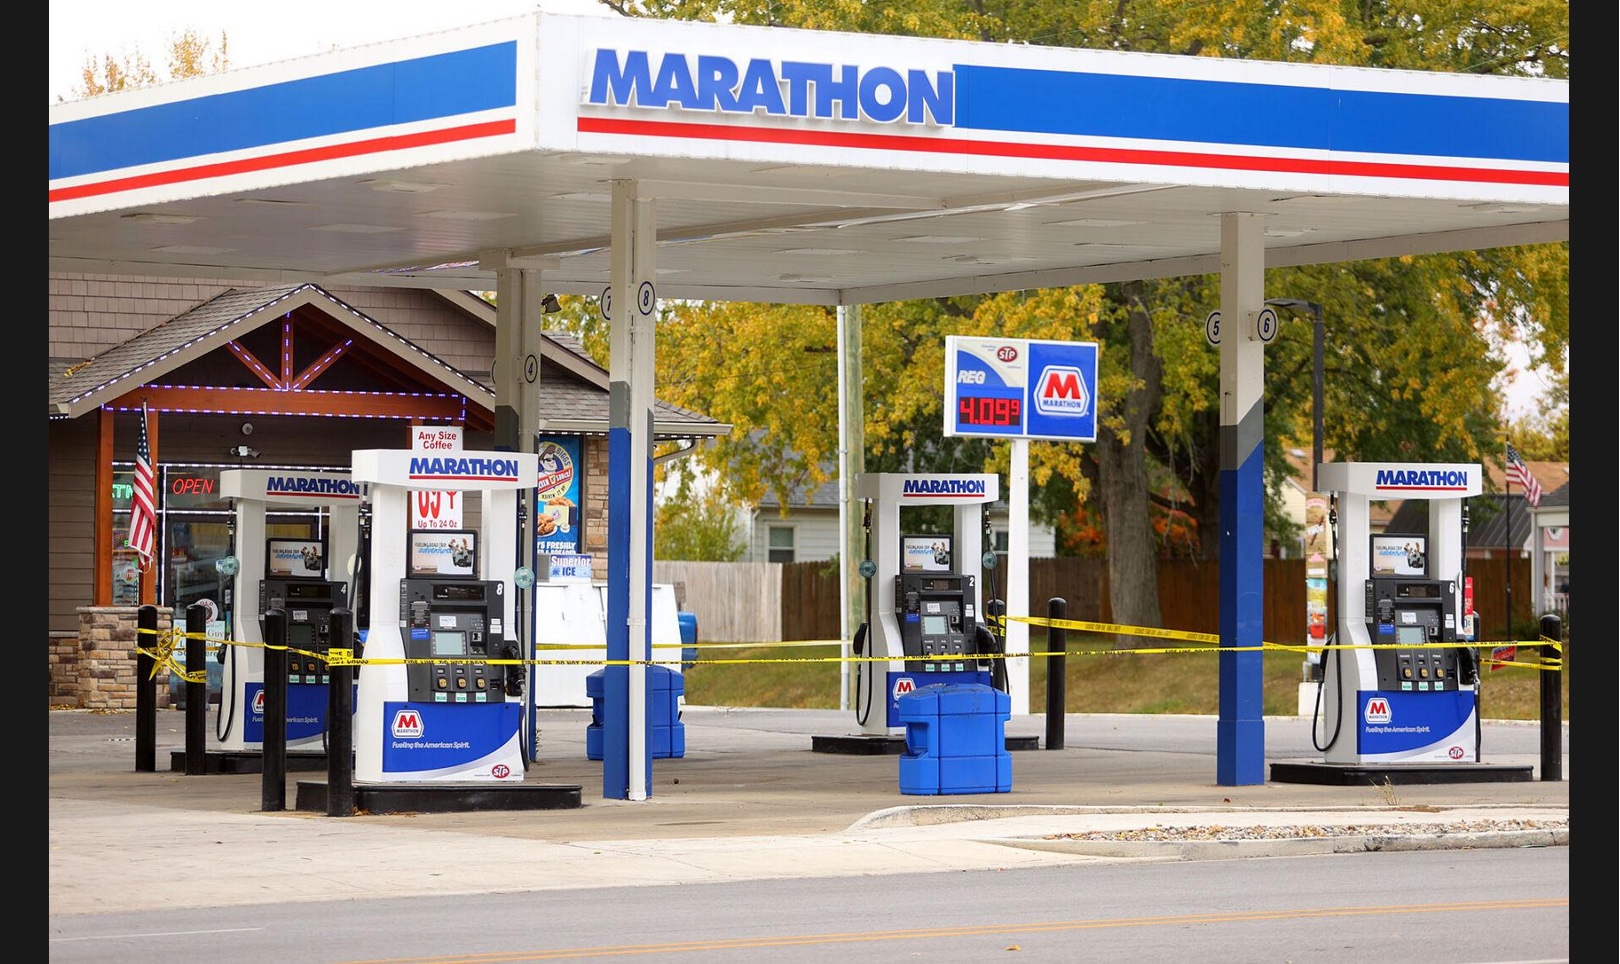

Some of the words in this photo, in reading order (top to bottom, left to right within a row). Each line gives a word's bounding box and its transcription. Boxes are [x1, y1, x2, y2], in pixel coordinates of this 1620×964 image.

[589, 47, 956, 126] MARATHON
[644, 290, 650, 306] 8
[1213, 320, 1220, 336] 5
[1264, 318, 1270, 333] 6
[999, 347, 1016, 361] STP
[528, 362, 533, 376] 4
[957, 370, 986, 384] REG
[1044, 372, 1081, 399] M
[1043, 400, 1081, 409] MARATHON
[418, 431, 436, 442] Any
[438, 431, 457, 440] Size
[423, 440, 452, 450] Coffee
[409, 457, 519, 476] MARATHON
[1376, 470, 1468, 486] MARATHON
[172, 478, 214, 495] OPEN
[266, 477, 360, 494] MARATHON
[903, 480, 985, 494] MARATHON
[418, 520, 428, 529] Up
[429, 520, 438, 528] To
[439, 520, 448, 528] 24
[449, 520, 457, 528] Oz
[546, 541, 577, 550] FRESHLY
[551, 555, 591, 568] Superior
[562, 566, 576, 577] ICE
[969, 577, 975, 587] 2
[1449, 582, 1455, 594] 6
[341, 584, 347, 594] 4
[496, 583, 503, 595] 8
[1370, 702, 1386, 714] M
[398, 715, 418, 728] M
[392, 742, 414, 750] Fueling
[1449, 747, 1463, 758] STP
[493, 766, 509, 777] STP
